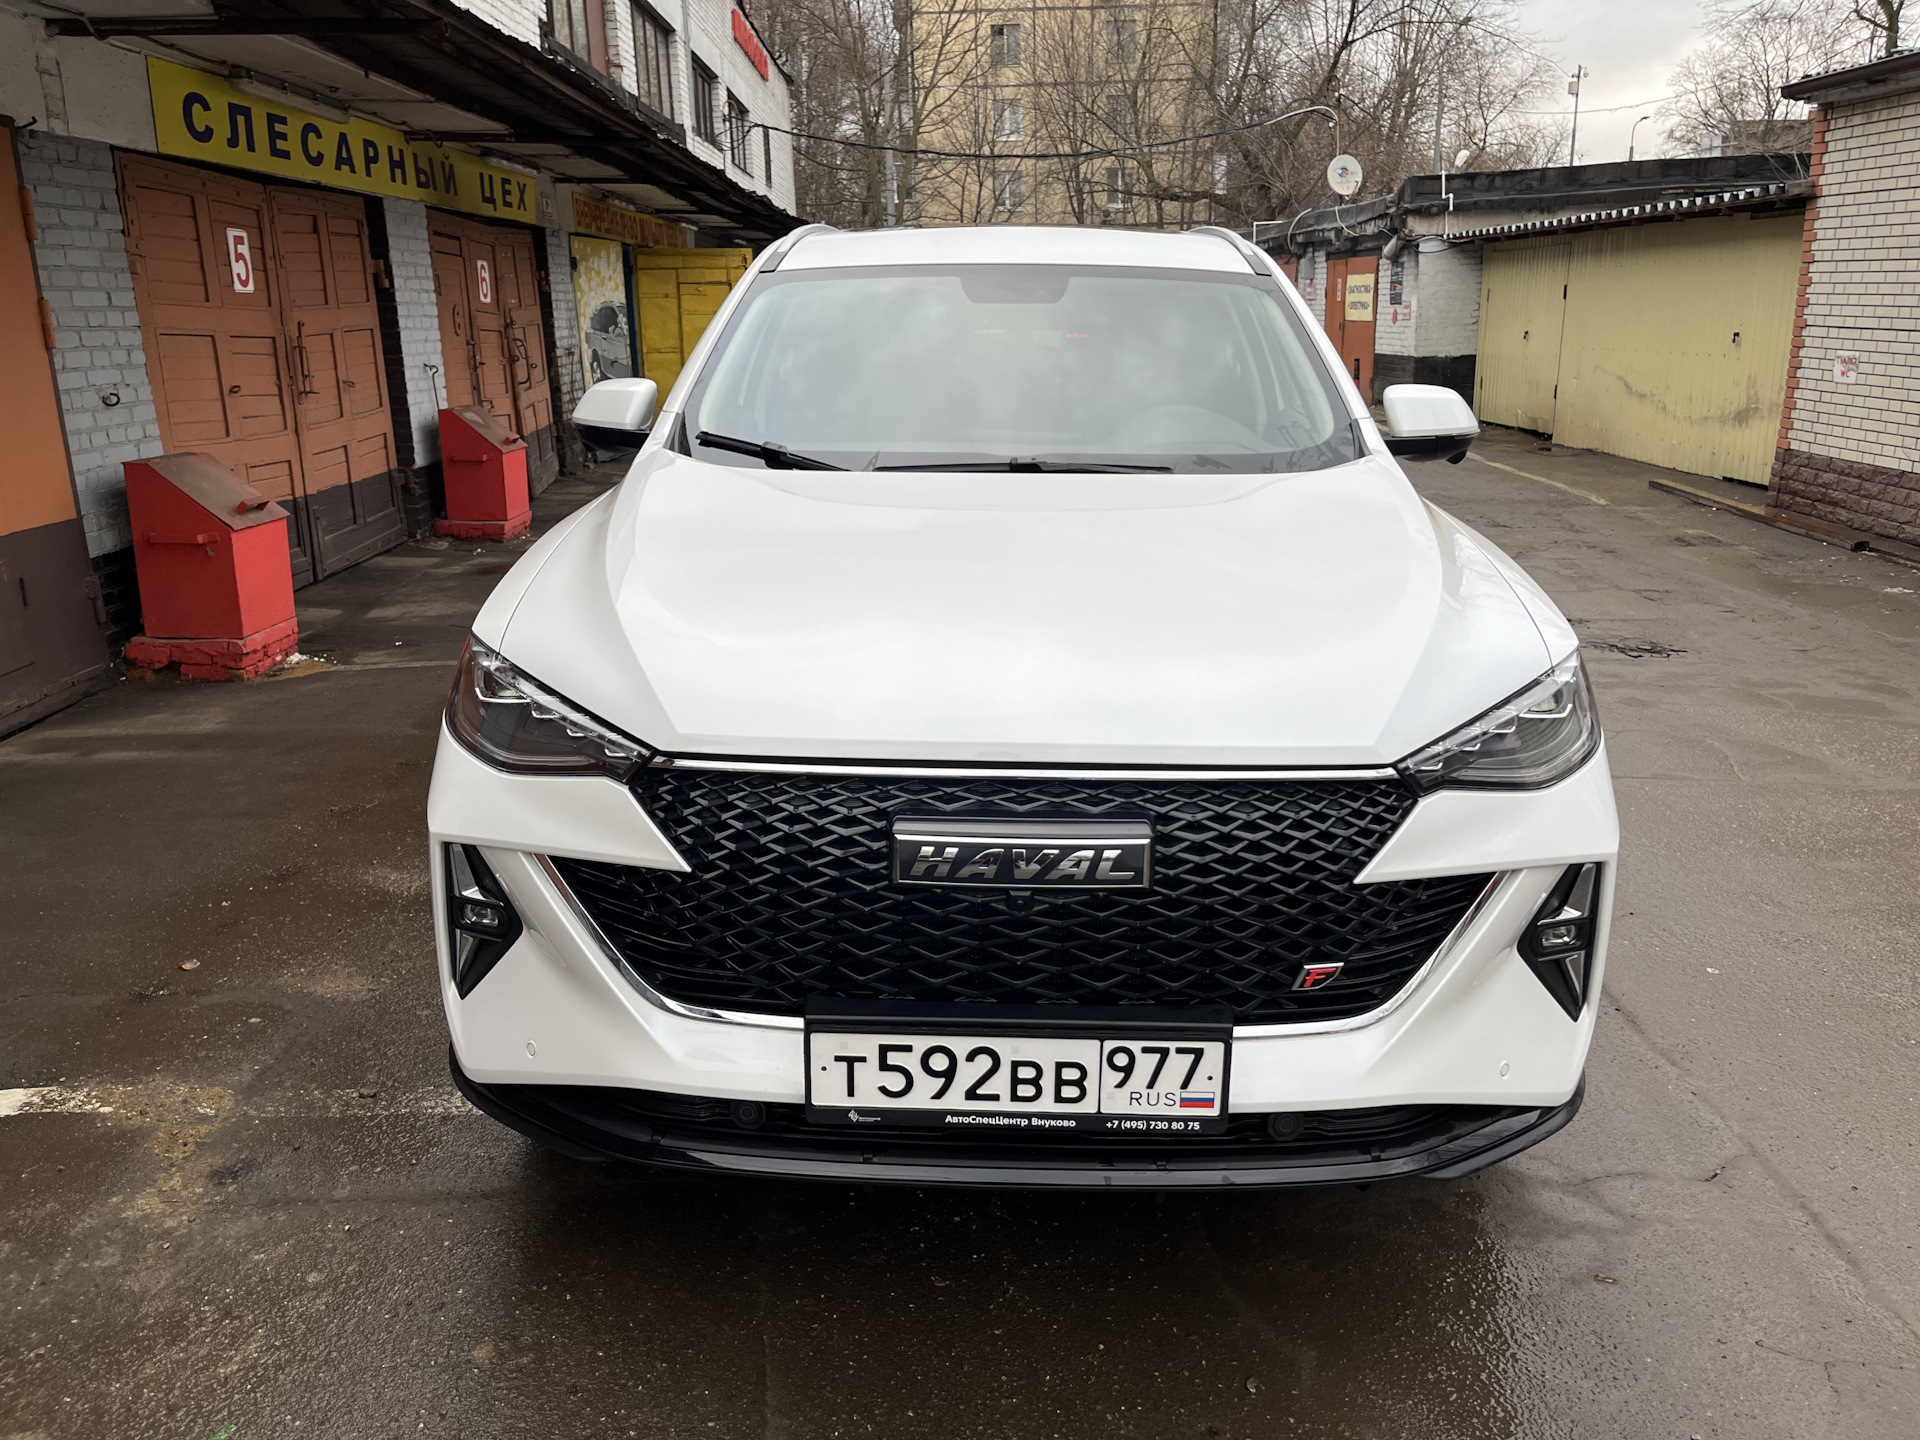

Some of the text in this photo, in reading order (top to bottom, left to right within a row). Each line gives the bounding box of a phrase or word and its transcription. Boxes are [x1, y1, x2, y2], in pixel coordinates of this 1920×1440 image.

[182, 91, 528, 212] СЛЕСАРНЫЙ ЦЕХ
[233, 235, 250, 288] 5
[479, 263, 489, 300] 6
[1841, 369, 1850, 378] WC
[909, 845, 1136, 881] HAVAL
[1303, 967, 1337, 988] F
[1106, 1045, 1205, 1090] 977
[1129, 1091, 1177, 1107] RUS
[945, 1115, 1076, 1128] АвтоСпецЦентр Внуково
[1106, 1119, 1200, 1131] +7 (495) 730 80 75
